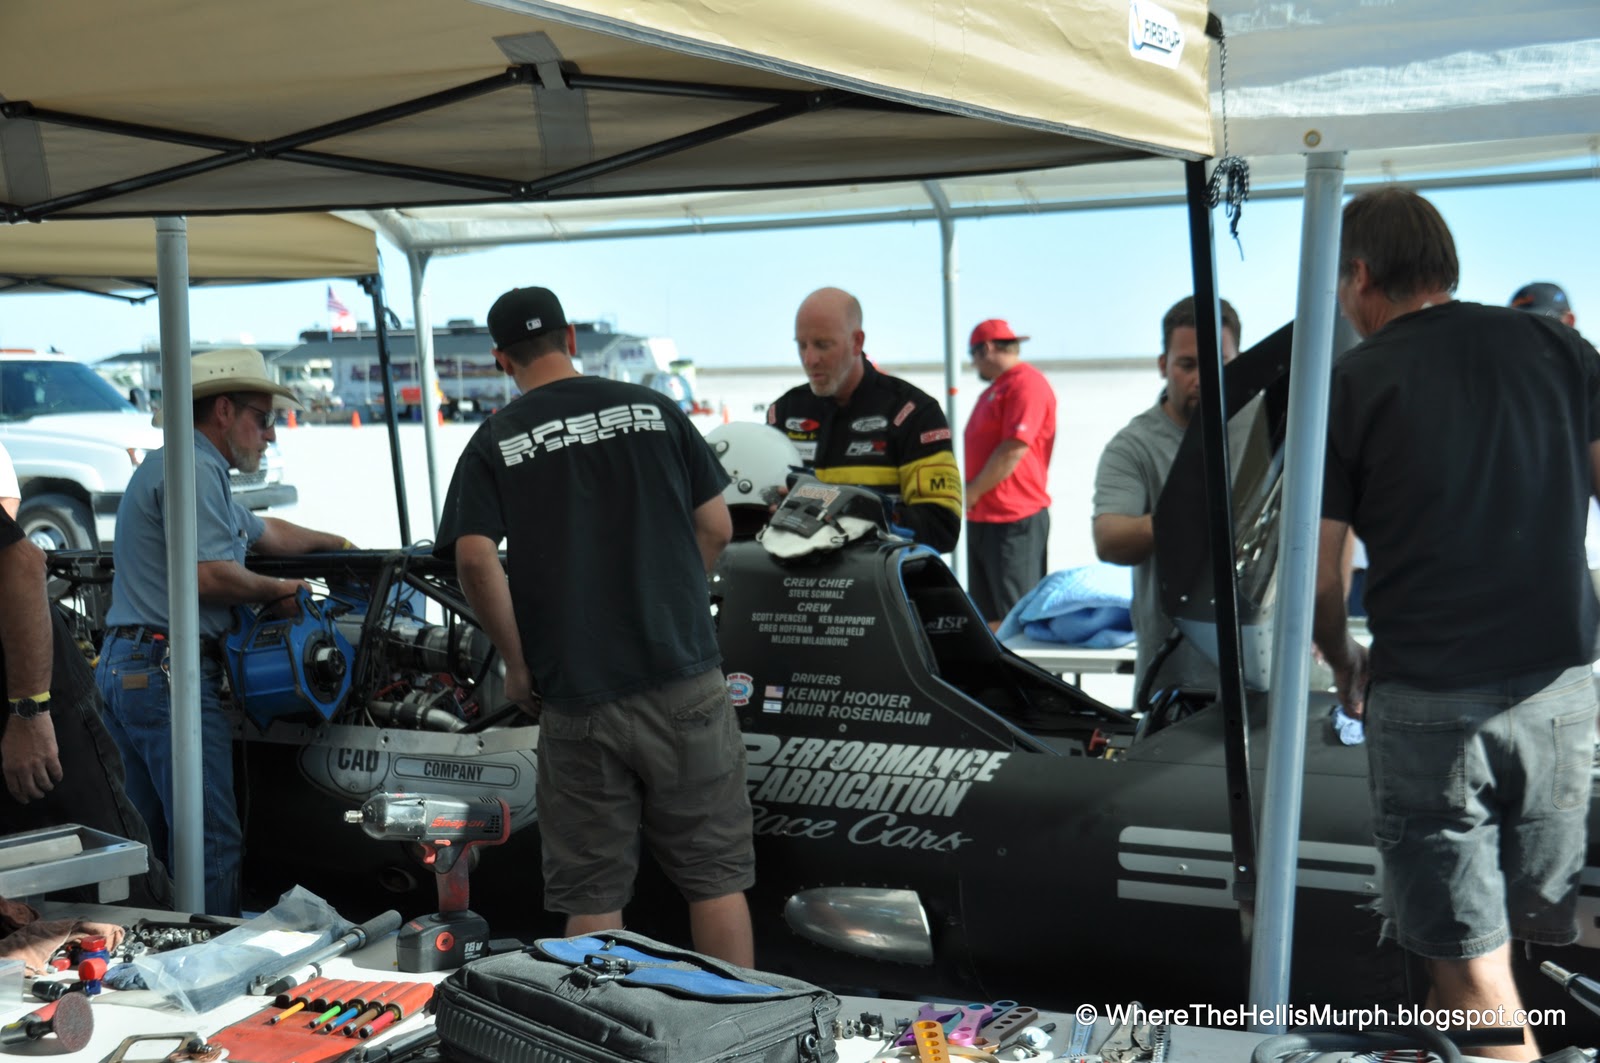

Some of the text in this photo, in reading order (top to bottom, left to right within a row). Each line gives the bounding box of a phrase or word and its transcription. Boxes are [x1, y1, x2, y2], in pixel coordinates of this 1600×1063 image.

[499, 403, 662, 456] SPEED
[504, 421, 666, 467] BY SPECTRE
[783, 577, 854, 588] CREW CHIEF
[788, 588, 844, 599] STEVE SCHMALZ
[797, 602, 831, 613] CREW
[751, 612, 807, 623] SCOTT SPENCER
[818, 615, 876, 626] KEN RAPPAPORT
[758, 623, 813, 635] GREG HOFFMAN
[825, 626, 865, 637] JOSH HELD
[771, 634, 849, 647] MLADEN MILADINOVIC
[791, 672, 841, 686] DRIVERS
[786, 686, 911, 709] KENNY HOOVER
[784, 702, 932, 726] AMIR ROSENBAUM
[741, 732, 1011, 782] PERFORMANCE
[423, 761, 484, 782] COMPANY
[430, 816, 487, 830] Snap-on
[848, 812, 973, 852] Cars
